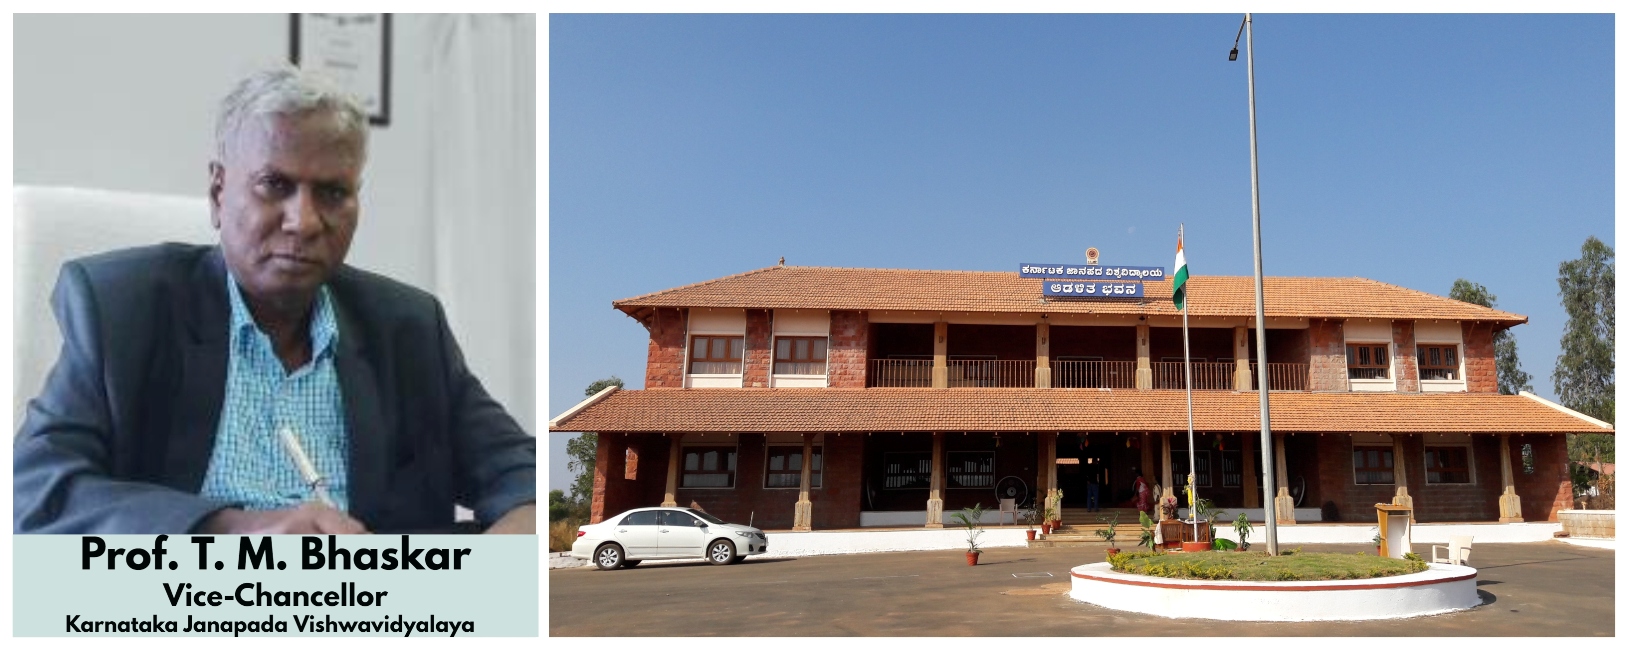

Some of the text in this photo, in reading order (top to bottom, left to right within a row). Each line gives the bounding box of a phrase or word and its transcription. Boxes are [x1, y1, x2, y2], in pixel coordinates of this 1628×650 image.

[1022, 264, 1163, 279] ಕರ್ನಾಟಕ ಜಾನಪದ ವಿಶ್ವವಿದ್ಯಾಲಯ
[1050, 282, 1136, 296] ಆಡಳಿತ ಭವನ
